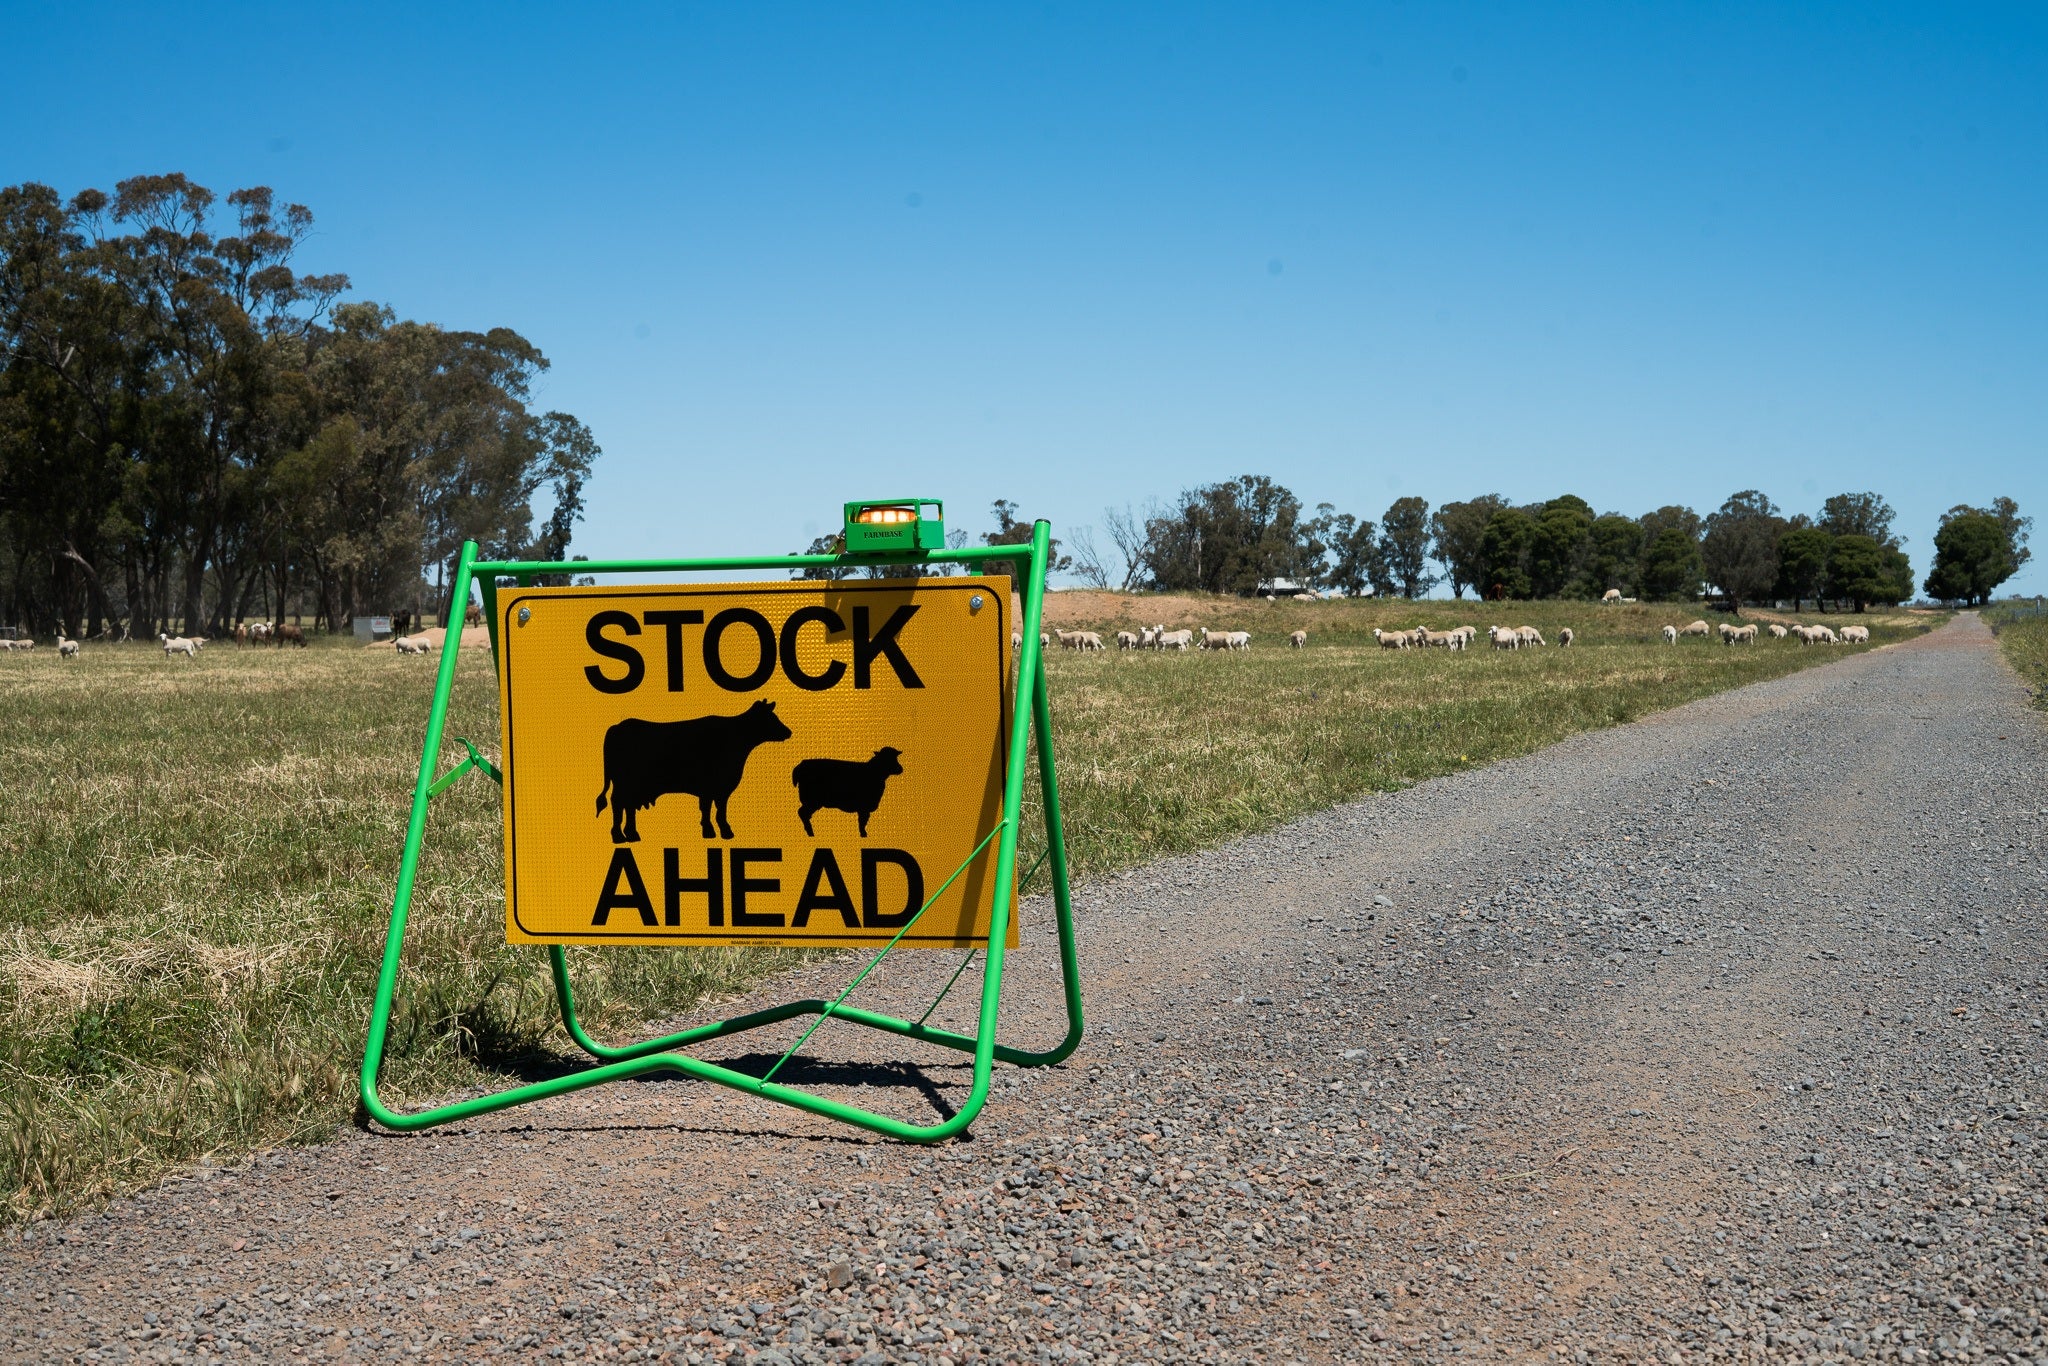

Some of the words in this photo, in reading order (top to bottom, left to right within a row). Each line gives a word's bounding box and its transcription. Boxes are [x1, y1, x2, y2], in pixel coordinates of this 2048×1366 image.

[863, 530, 904, 539] FARMBASE
[584, 603, 926, 695] STOCK
[591, 847, 925, 929] AHEAD
